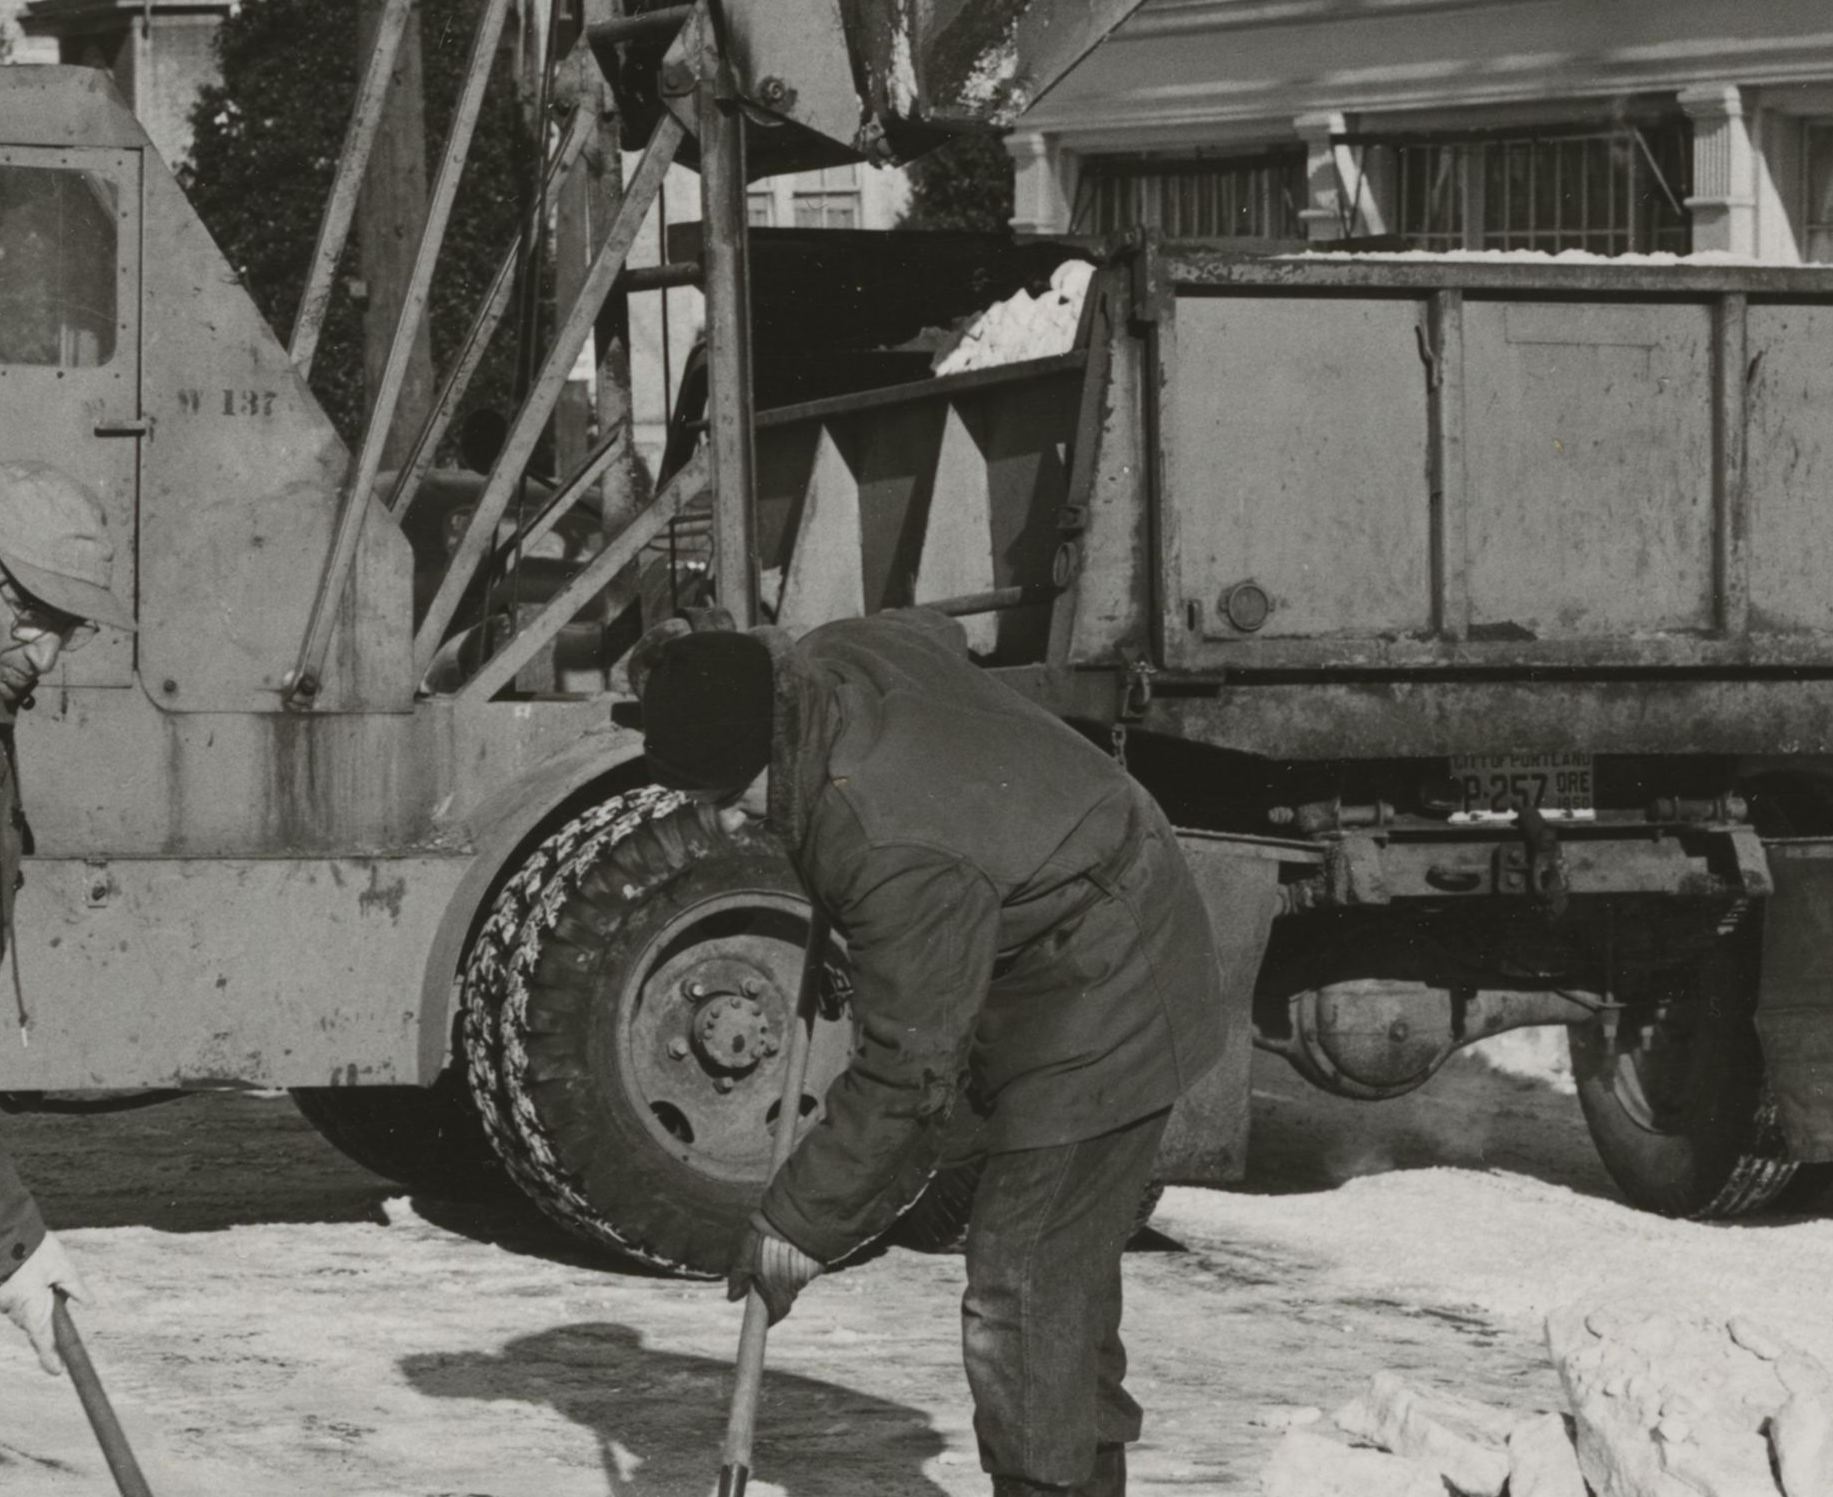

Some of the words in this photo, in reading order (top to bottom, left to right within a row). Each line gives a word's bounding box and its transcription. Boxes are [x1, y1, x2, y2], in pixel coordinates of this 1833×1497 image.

[222, 389, 277, 416] 137
[1510, 752, 1591, 768] PORTLAND
[1556, 771, 1591, 793] ORE
